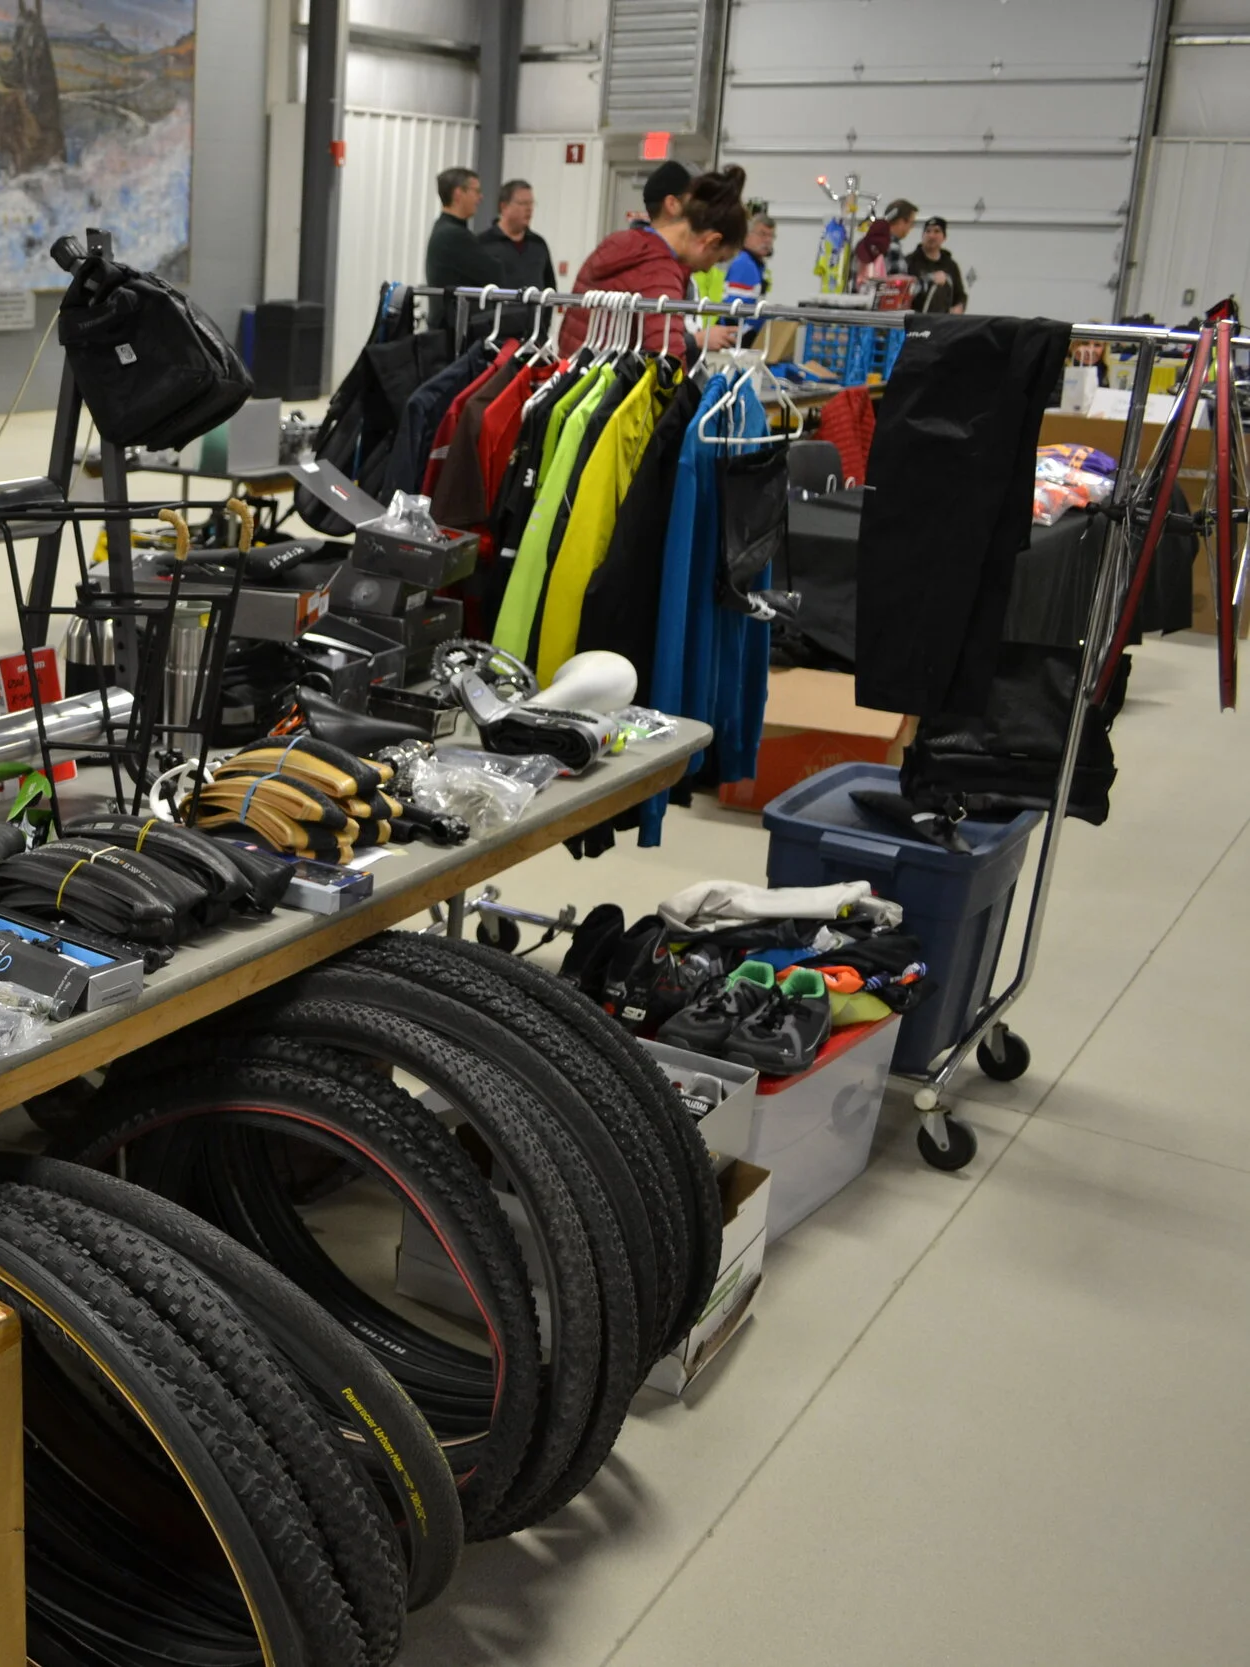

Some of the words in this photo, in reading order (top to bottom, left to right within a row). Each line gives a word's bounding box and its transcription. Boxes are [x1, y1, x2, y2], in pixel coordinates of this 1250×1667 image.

[353, 1321, 407, 1355] RITCHEY
[342, 1387, 377, 1428] Panaracer
[374, 1427, 395, 1455] Urban
[390, 1453, 404, 1473] Max
